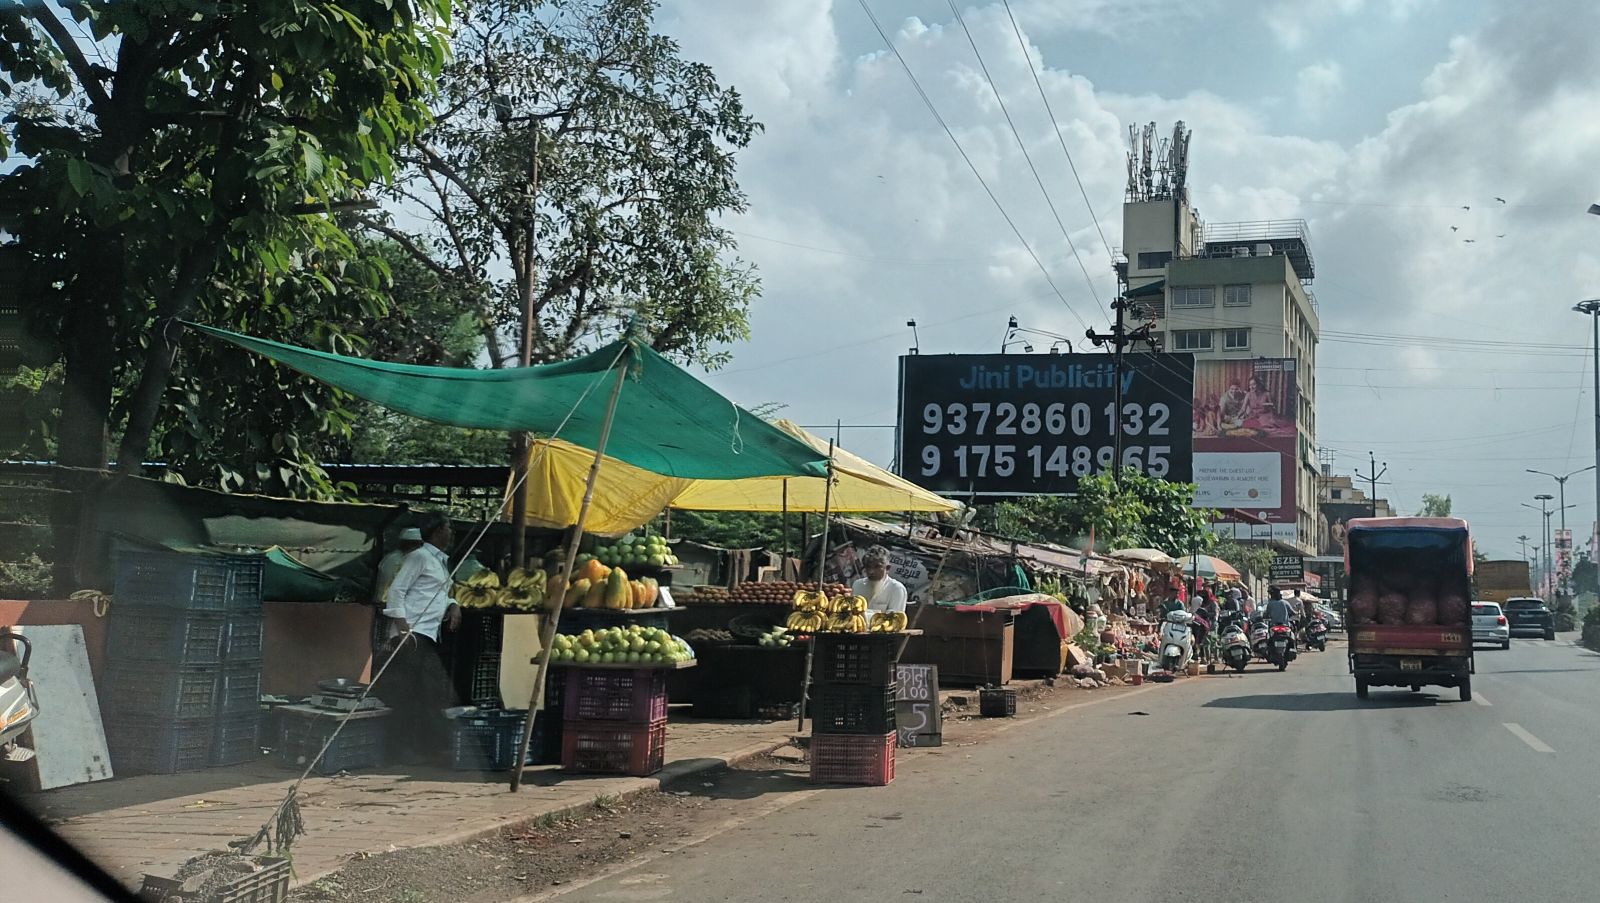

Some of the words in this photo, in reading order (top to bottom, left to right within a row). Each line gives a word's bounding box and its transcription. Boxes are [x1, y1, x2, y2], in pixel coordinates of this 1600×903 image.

[960, 363, 1010, 390] Jini
[1017, 363, 1136, 395] Publicity
[923, 402, 1091, 436] 9372860
[1104, 402, 1170, 436] 132
[953, 445, 1016, 478] 175
[897, 687, 928, 700] 100
[903, 703, 930, 731] 5
